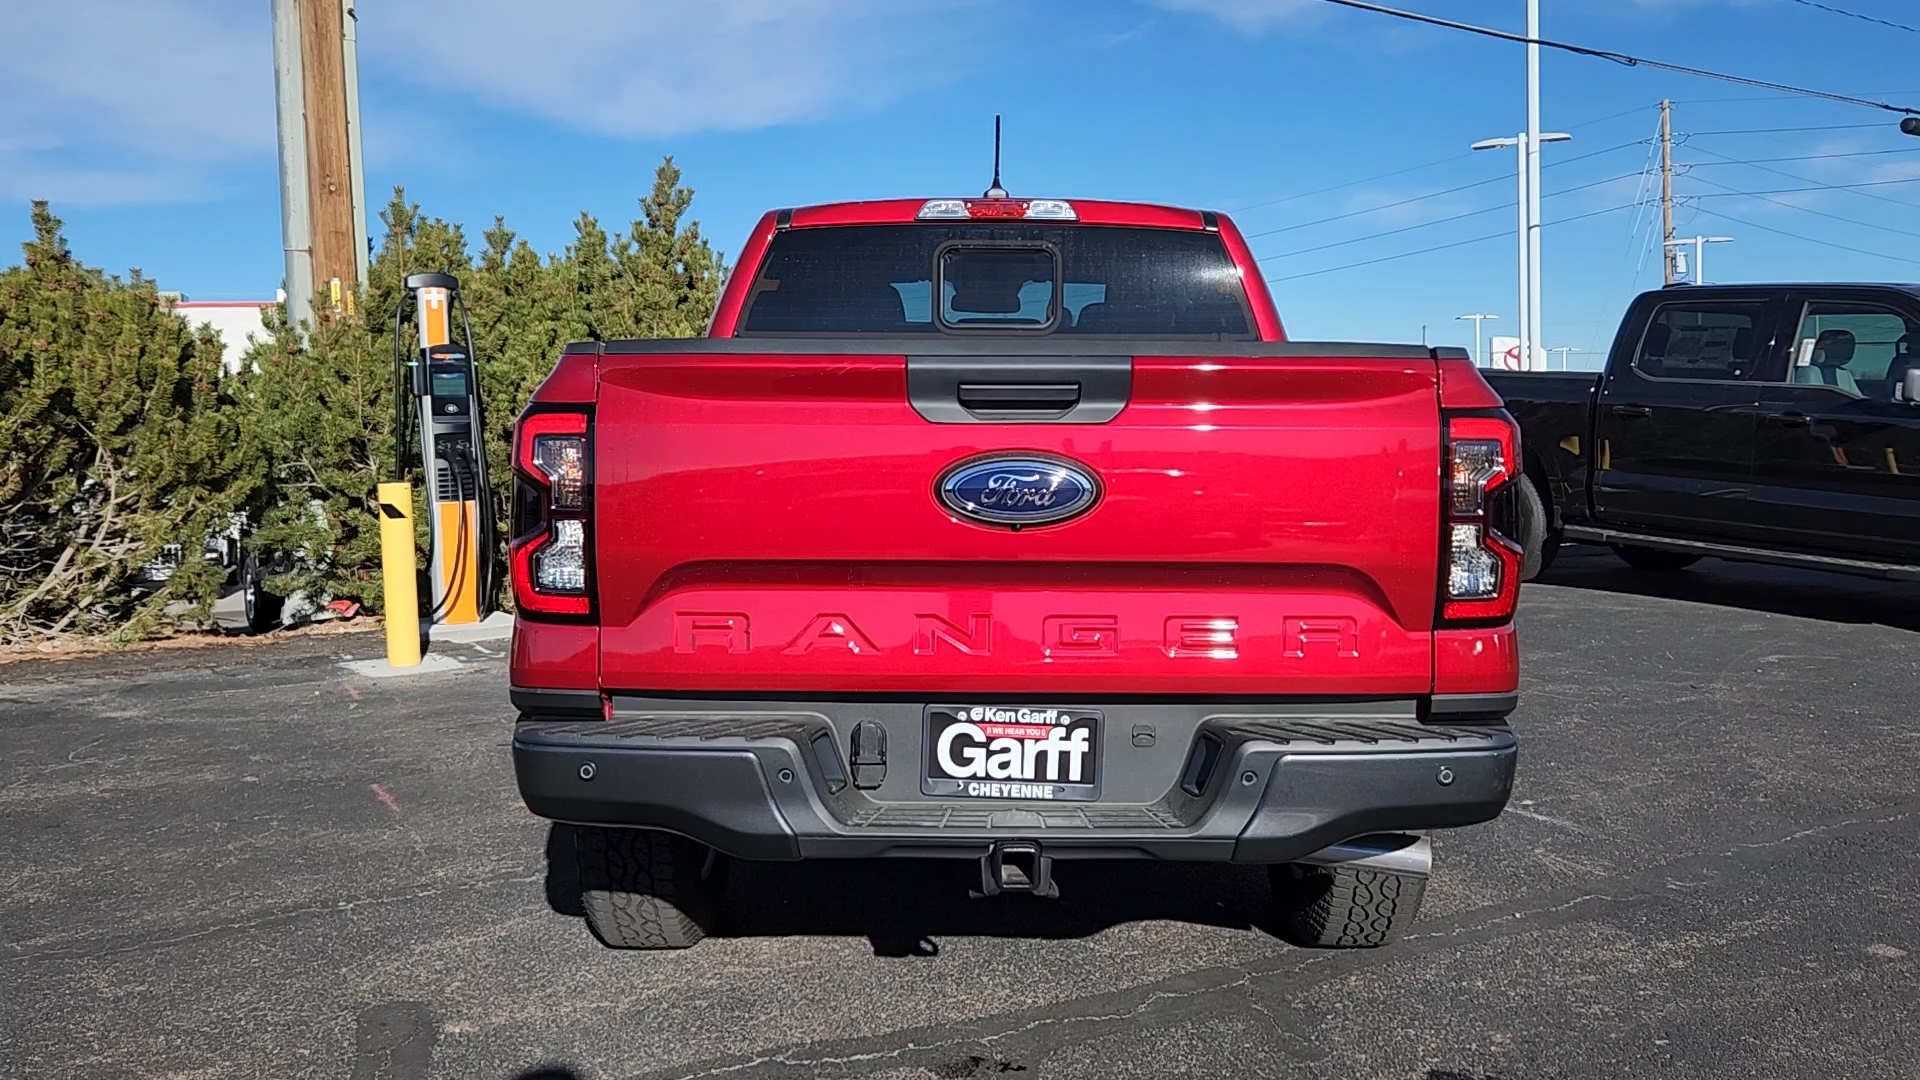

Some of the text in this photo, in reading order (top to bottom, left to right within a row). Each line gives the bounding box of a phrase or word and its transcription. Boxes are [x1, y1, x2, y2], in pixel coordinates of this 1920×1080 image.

[981, 473, 1058, 507] Ford
[673, 610, 1359, 658] RANGER
[985, 708, 1016, 722] Ken
[1017, 709, 1057, 724] Garff
[992, 726, 1040, 736] WE HEAR YOU
[937, 722, 1089, 781] Garff
[968, 783, 1053, 798] CHEYENNE
